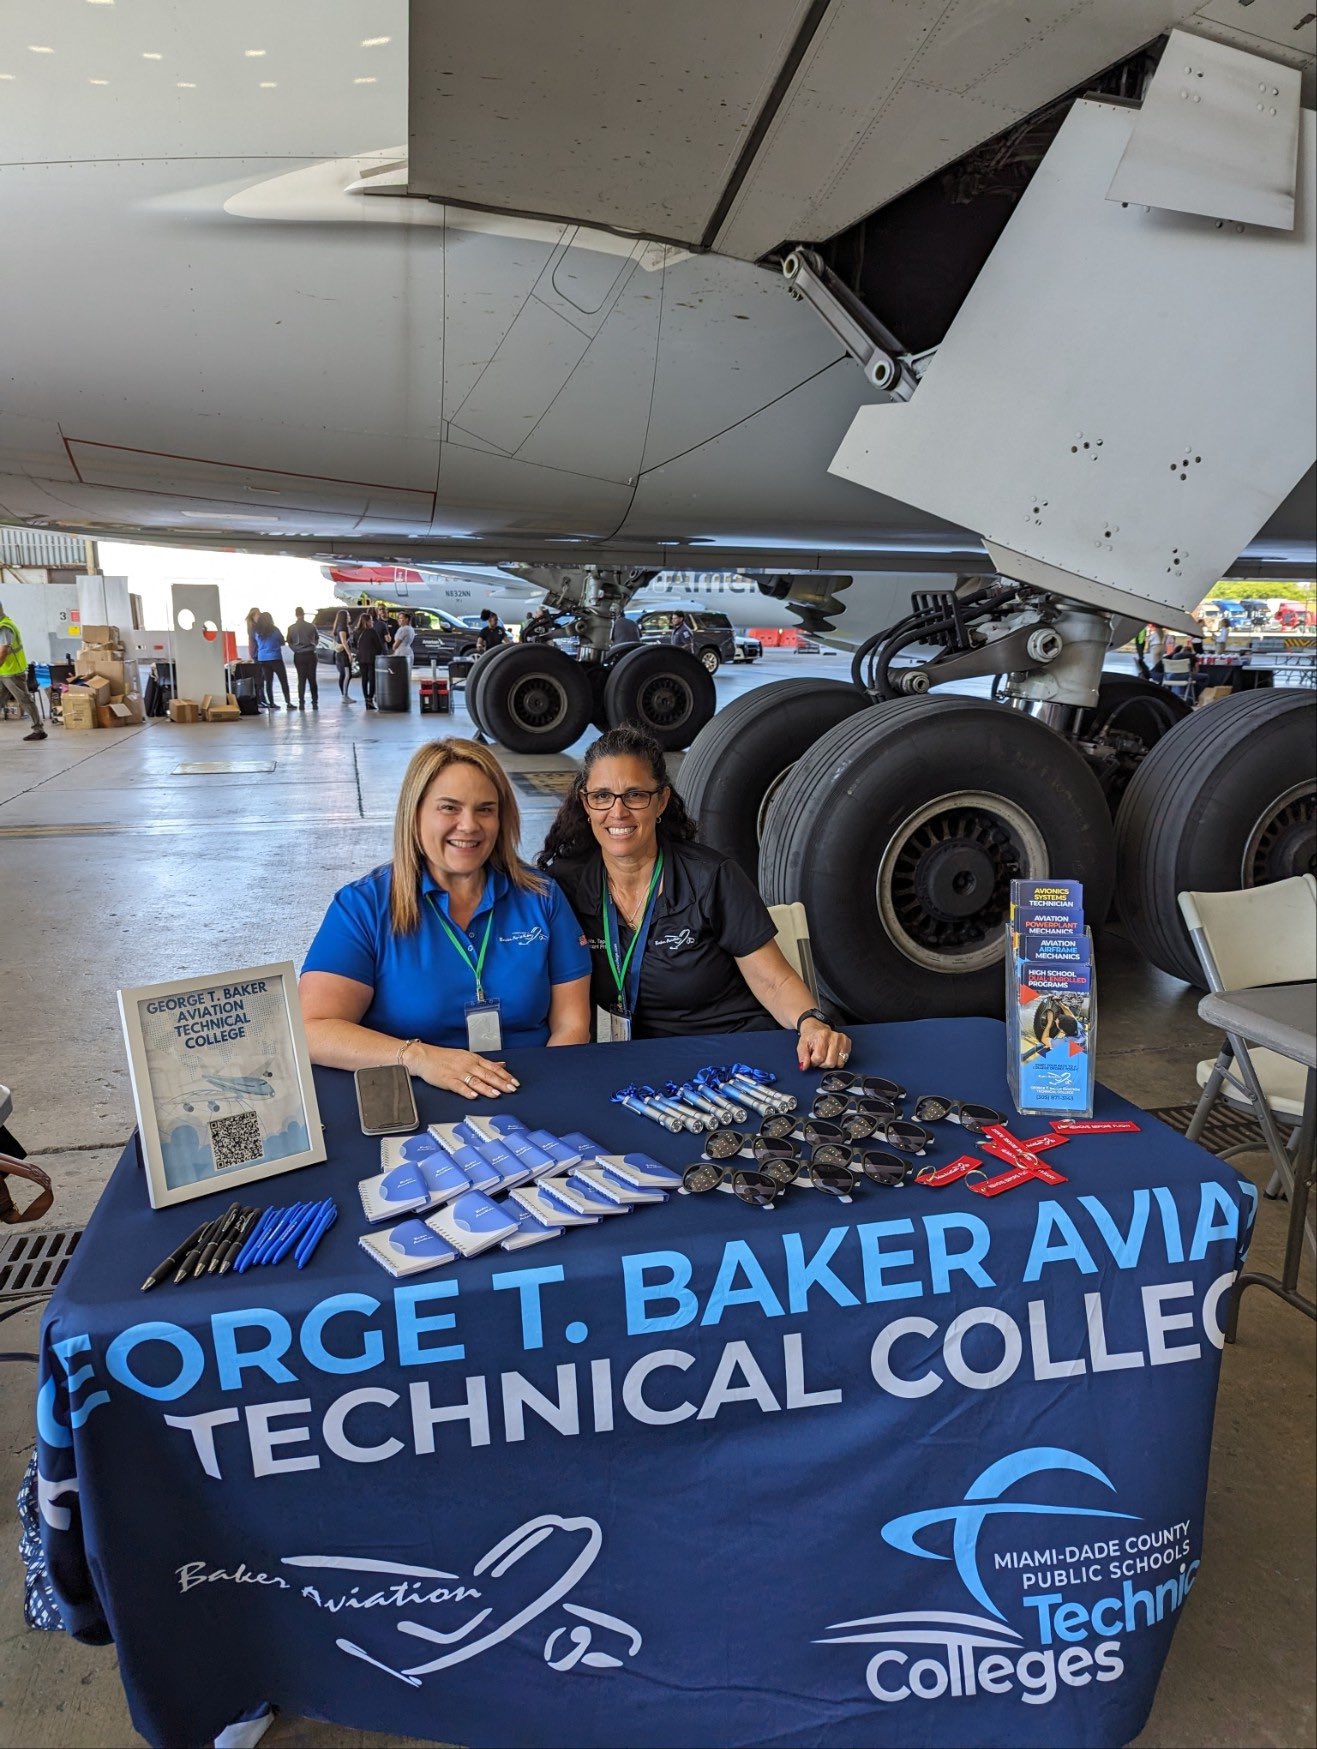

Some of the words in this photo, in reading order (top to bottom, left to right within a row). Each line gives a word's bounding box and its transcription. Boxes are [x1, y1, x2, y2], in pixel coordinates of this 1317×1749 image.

[59, 611, 67, 621] 3
[1029, 900, 1074, 908] TECHNICIAN
[1025, 921, 1078, 929] POWERPLANT
[1034, 915, 1069, 923] AVIATION
[1038, 946, 1078, 954] AIRFRAME
[1028, 975, 1087, 984] DUAL-ENROLLED
[1028, 981, 1069, 989] PROGRAMS
[1047, 970, 1077, 978] SCHOOL
[146, 993, 206, 1015] GEORGE
[207, 991, 221, 1003] T.
[223, 981, 268, 1000] BAKER
[177, 999, 245, 1023] AVIATION
[173, 1012, 251, 1038] TECHNICAL
[185, 1026, 246, 1049] COLLEGE
[492, 1264, 588, 1350] T.
[621, 1212, 996, 1335] BAKER
[164, 1333, 842, 1479] TECHNICAL
[994, 1539, 1121, 1570] MIAMI-DADE
[1125, 1520, 1191, 1554] COUNTY
[1022, 1561, 1103, 1590] PUBLIC
[1109, 1540, 1190, 1579] SCHOOLS
[175, 1561, 291, 1593] Baker
[301, 1580, 482, 1613] Aviation
[865, 1640, 1125, 1705] Colleges
